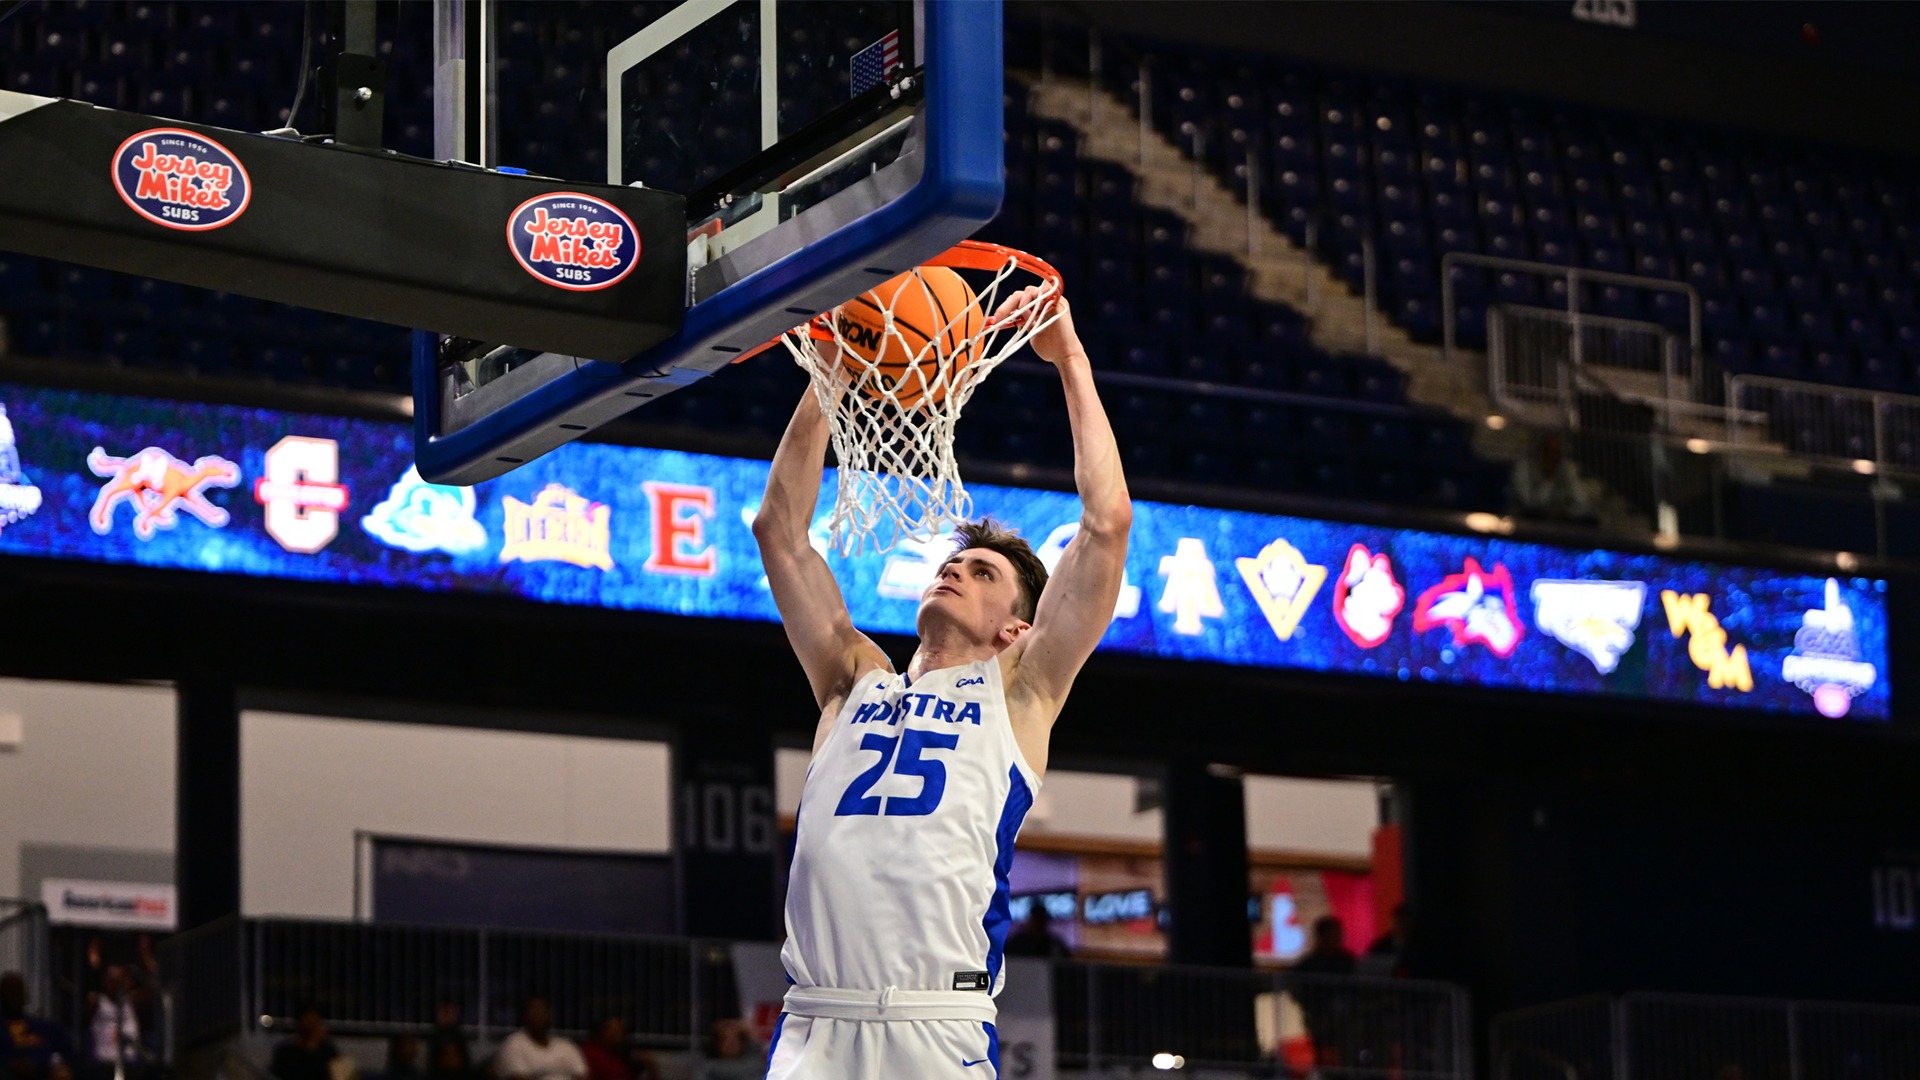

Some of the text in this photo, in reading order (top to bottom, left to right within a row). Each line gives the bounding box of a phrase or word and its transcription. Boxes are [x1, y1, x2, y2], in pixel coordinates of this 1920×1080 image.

[161, 139, 207, 153] SINCE 1956
[132, 143, 232, 190] Jersey
[136, 170, 230, 210] Mike's
[162, 206, 199, 221] SUBS
[579, 204, 598, 214] 1956
[525, 208, 622, 249] Jersey
[530, 234, 620, 269] Mike's
[556, 267, 591, 281] SUBS
[642, 481, 716, 576] E
[956, 676, 985, 688] CAA
[834, 728, 959, 816] 25
[678, 782, 773, 854] 106
